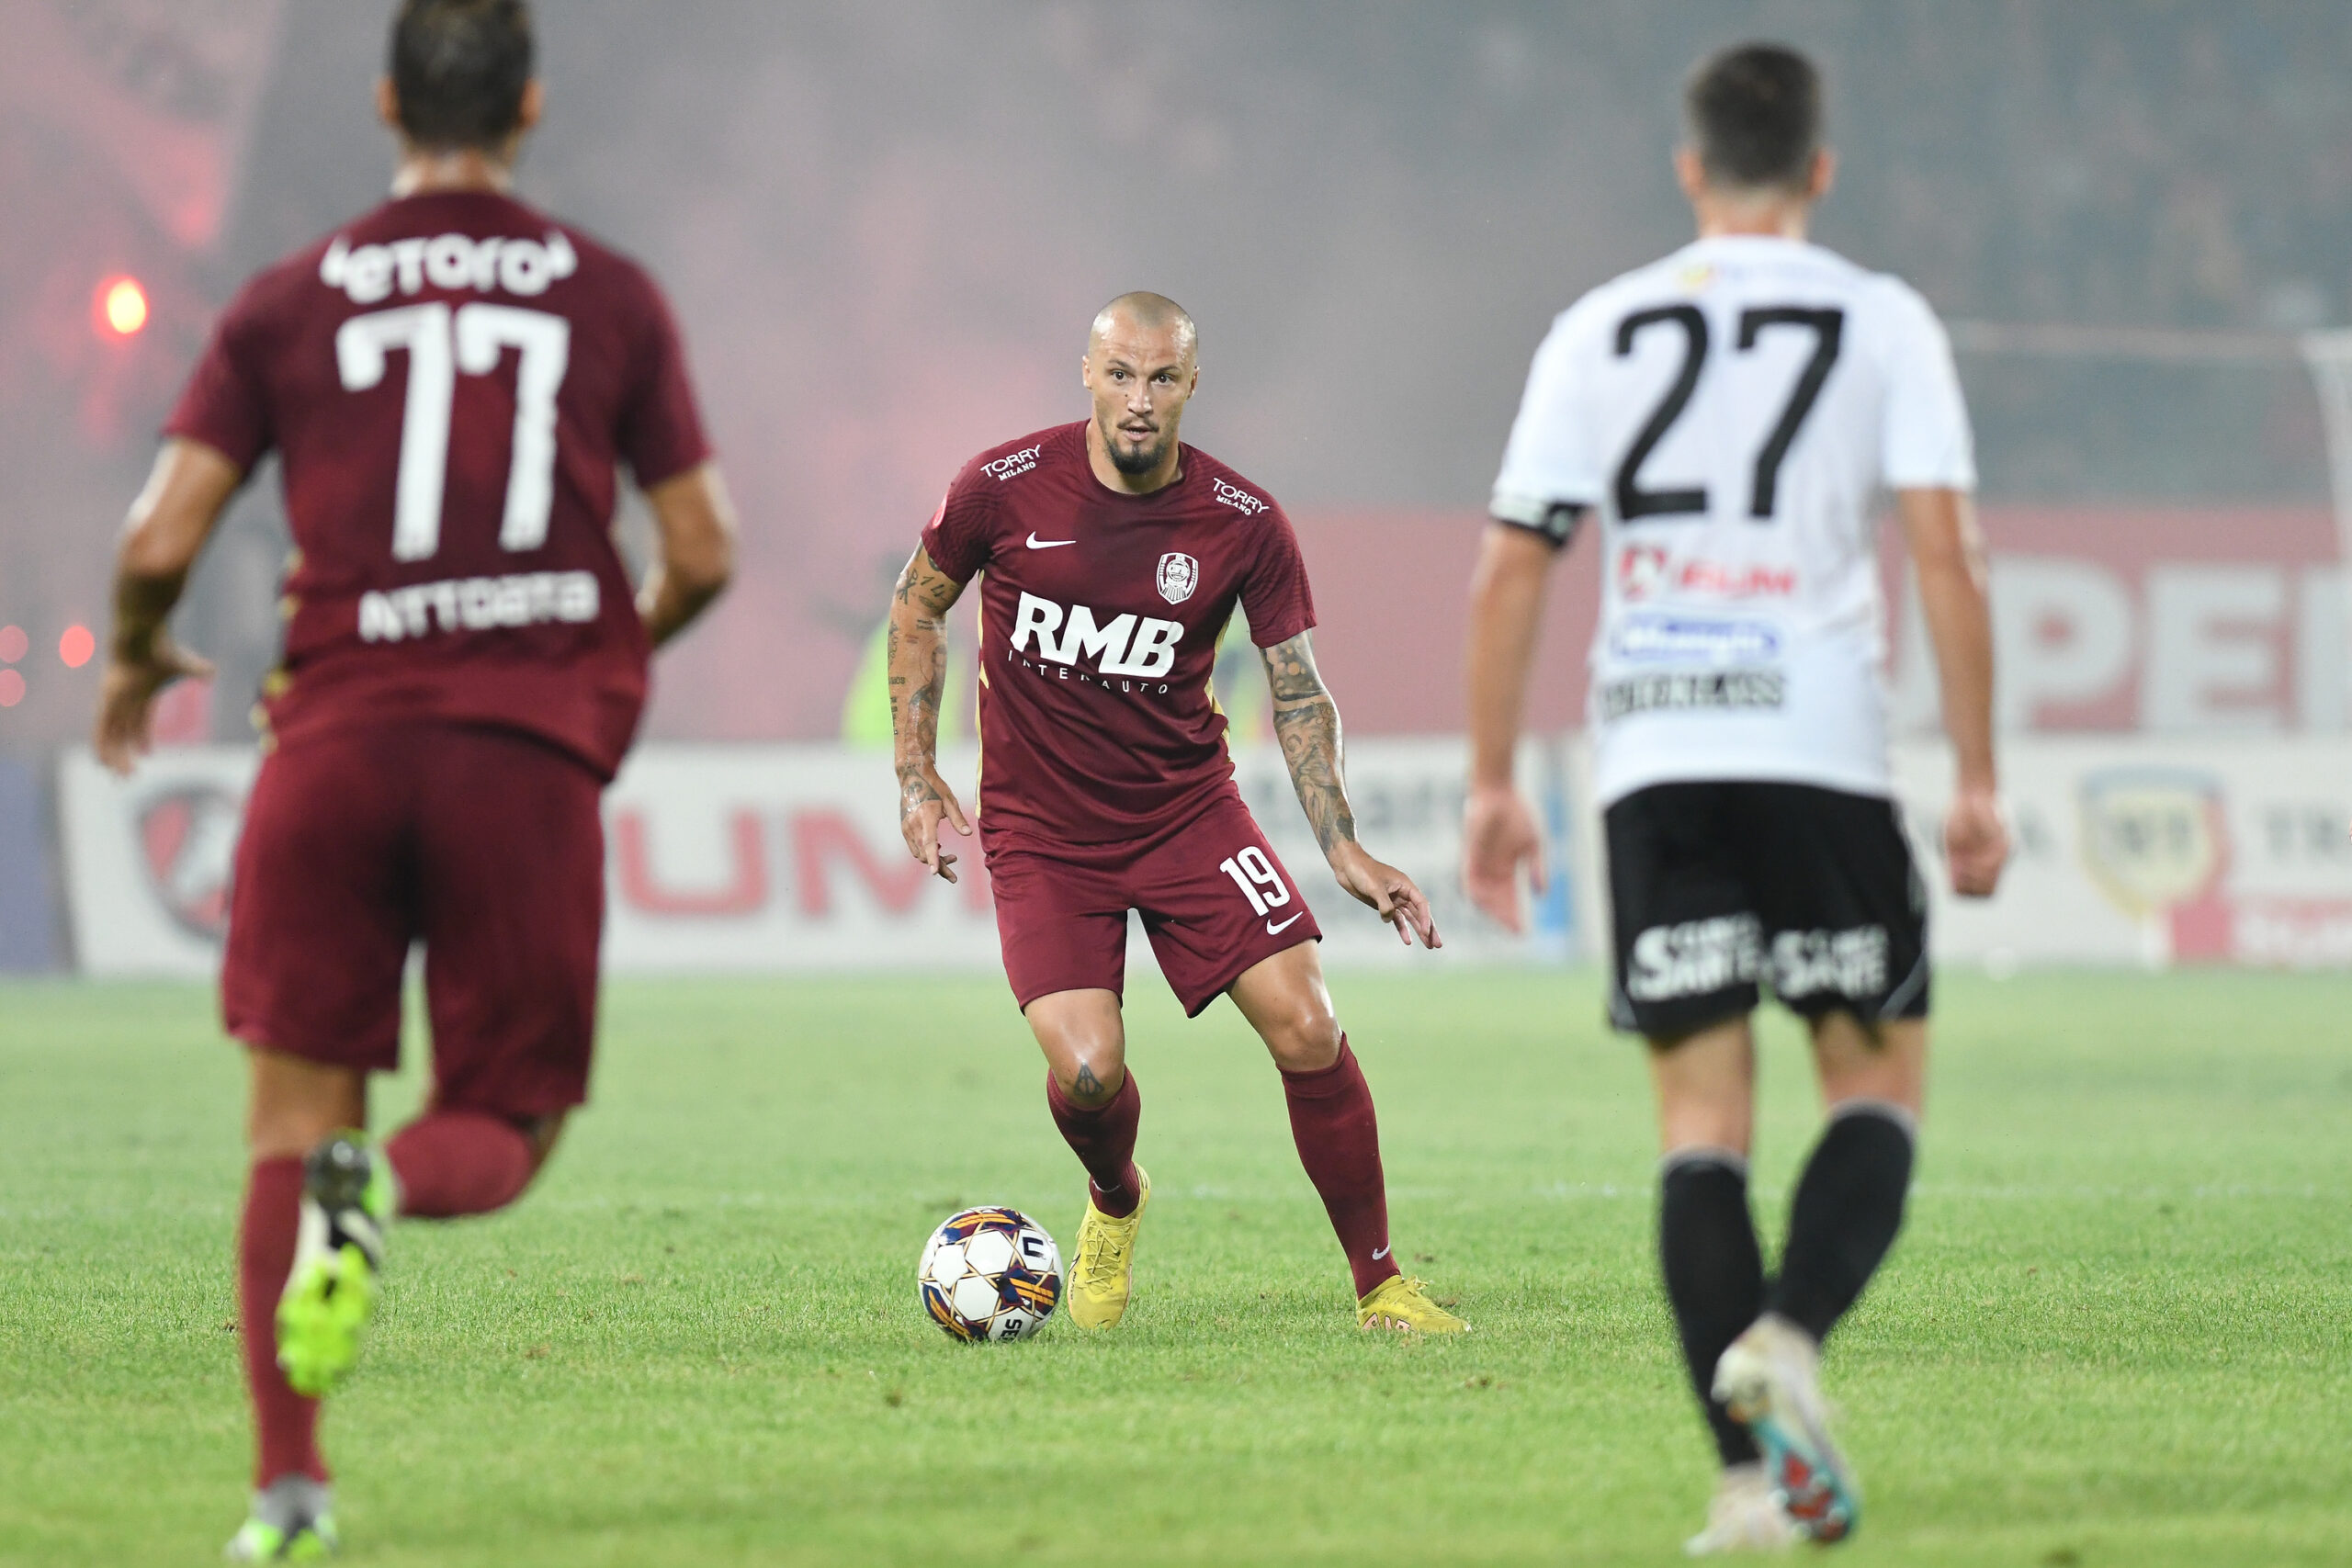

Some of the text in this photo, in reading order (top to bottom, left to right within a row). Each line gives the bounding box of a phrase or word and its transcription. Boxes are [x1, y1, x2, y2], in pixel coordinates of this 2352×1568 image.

[336, 300, 570, 562] 77
[1613, 305, 1845, 521] 27
[980, 444, 1041, 478] TORRY
[998, 461, 1036, 481] MILANO
[1213, 477, 1270, 513] TORRY
[1216, 494, 1251, 516] MILANO
[1010, 591, 1185, 678] RMB
[1219, 845, 1290, 917] 19
